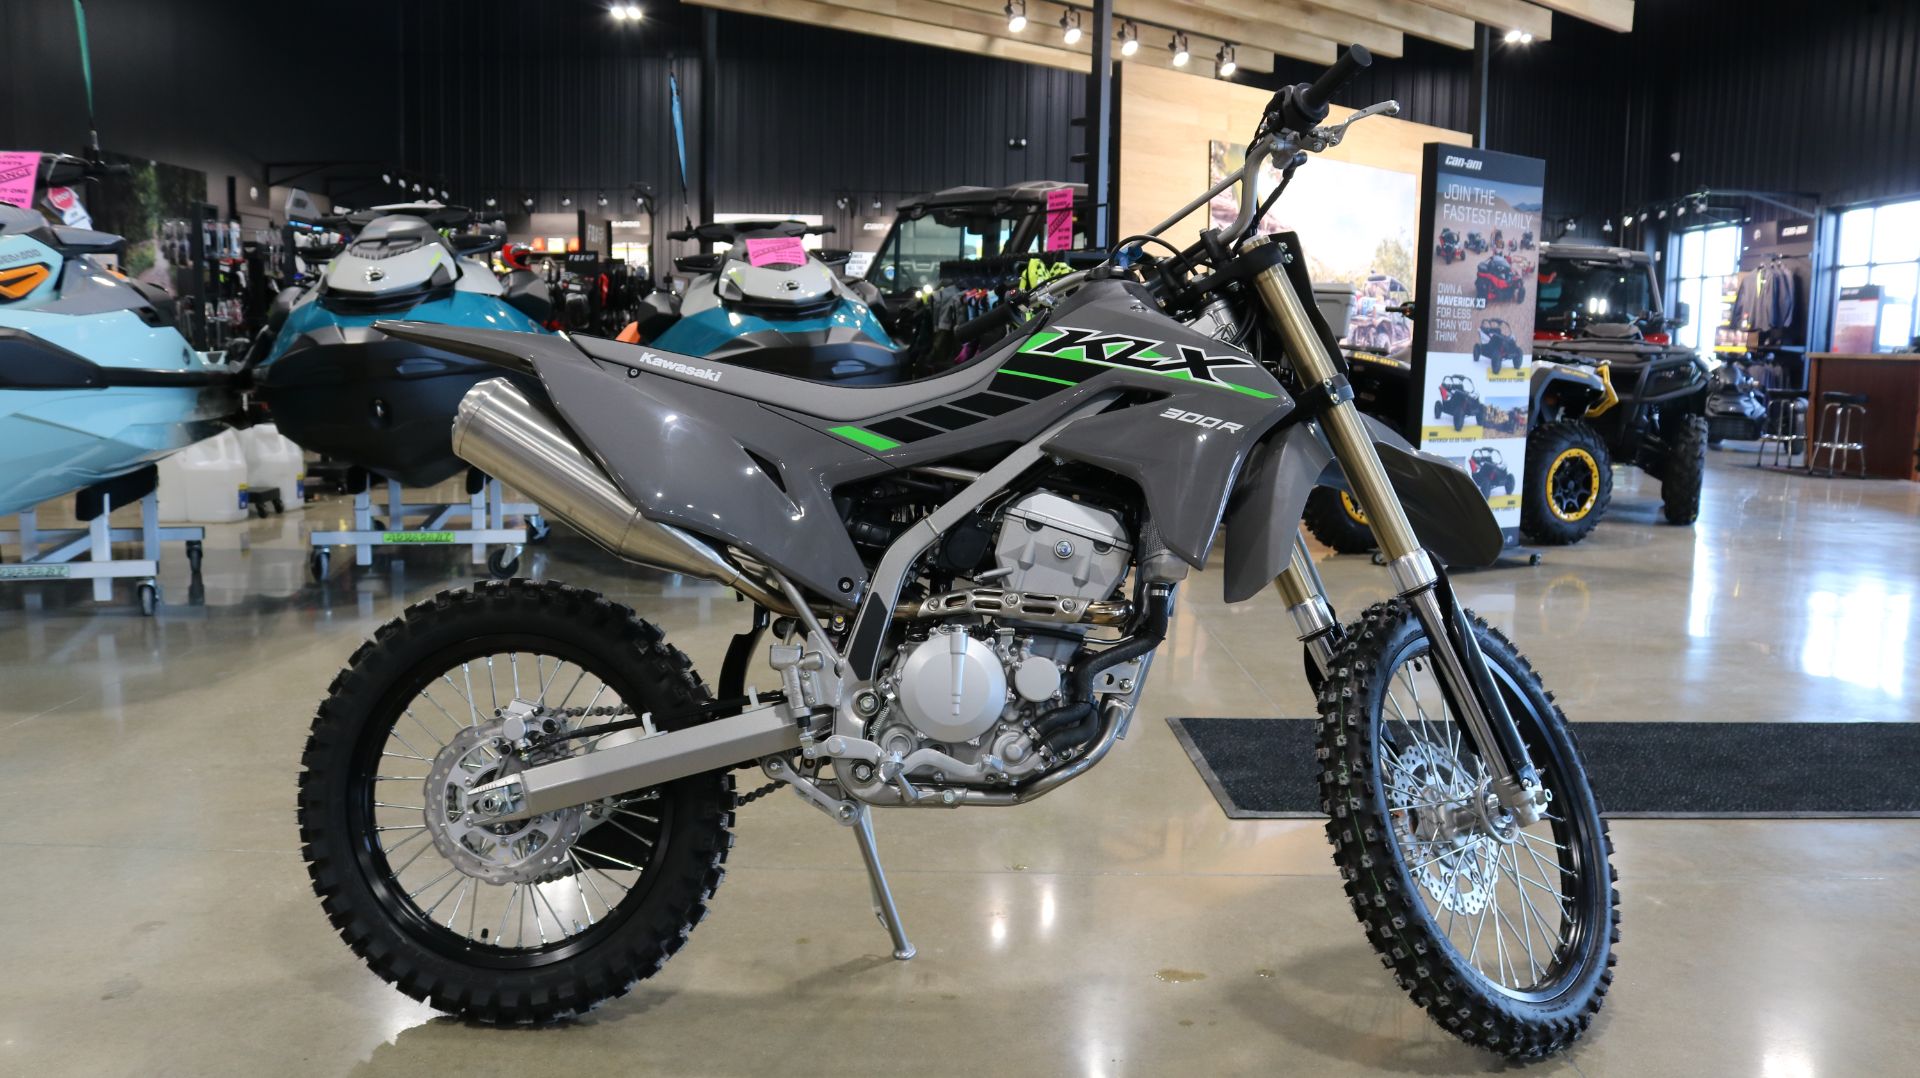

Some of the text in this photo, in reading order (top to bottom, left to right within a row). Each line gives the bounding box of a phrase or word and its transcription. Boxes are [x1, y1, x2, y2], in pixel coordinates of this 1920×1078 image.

[1445, 155, 1483, 171] can-am
[1444, 183, 1496, 206] JOIN THE
[1443, 203, 1534, 231] FASTEST FAMILY
[1437, 282, 1464, 296] OWN A
[1436, 294, 1487, 309] MAVERICK X3
[1436, 306, 1472, 320] FOR LESS
[1435, 318, 1473, 331] THAN YOU
[1434, 330, 1458, 342] THINK
[1026, 325, 1257, 389] KLX
[639, 351, 723, 382] Kawasaki
[1159, 407, 1245, 434] 300R
